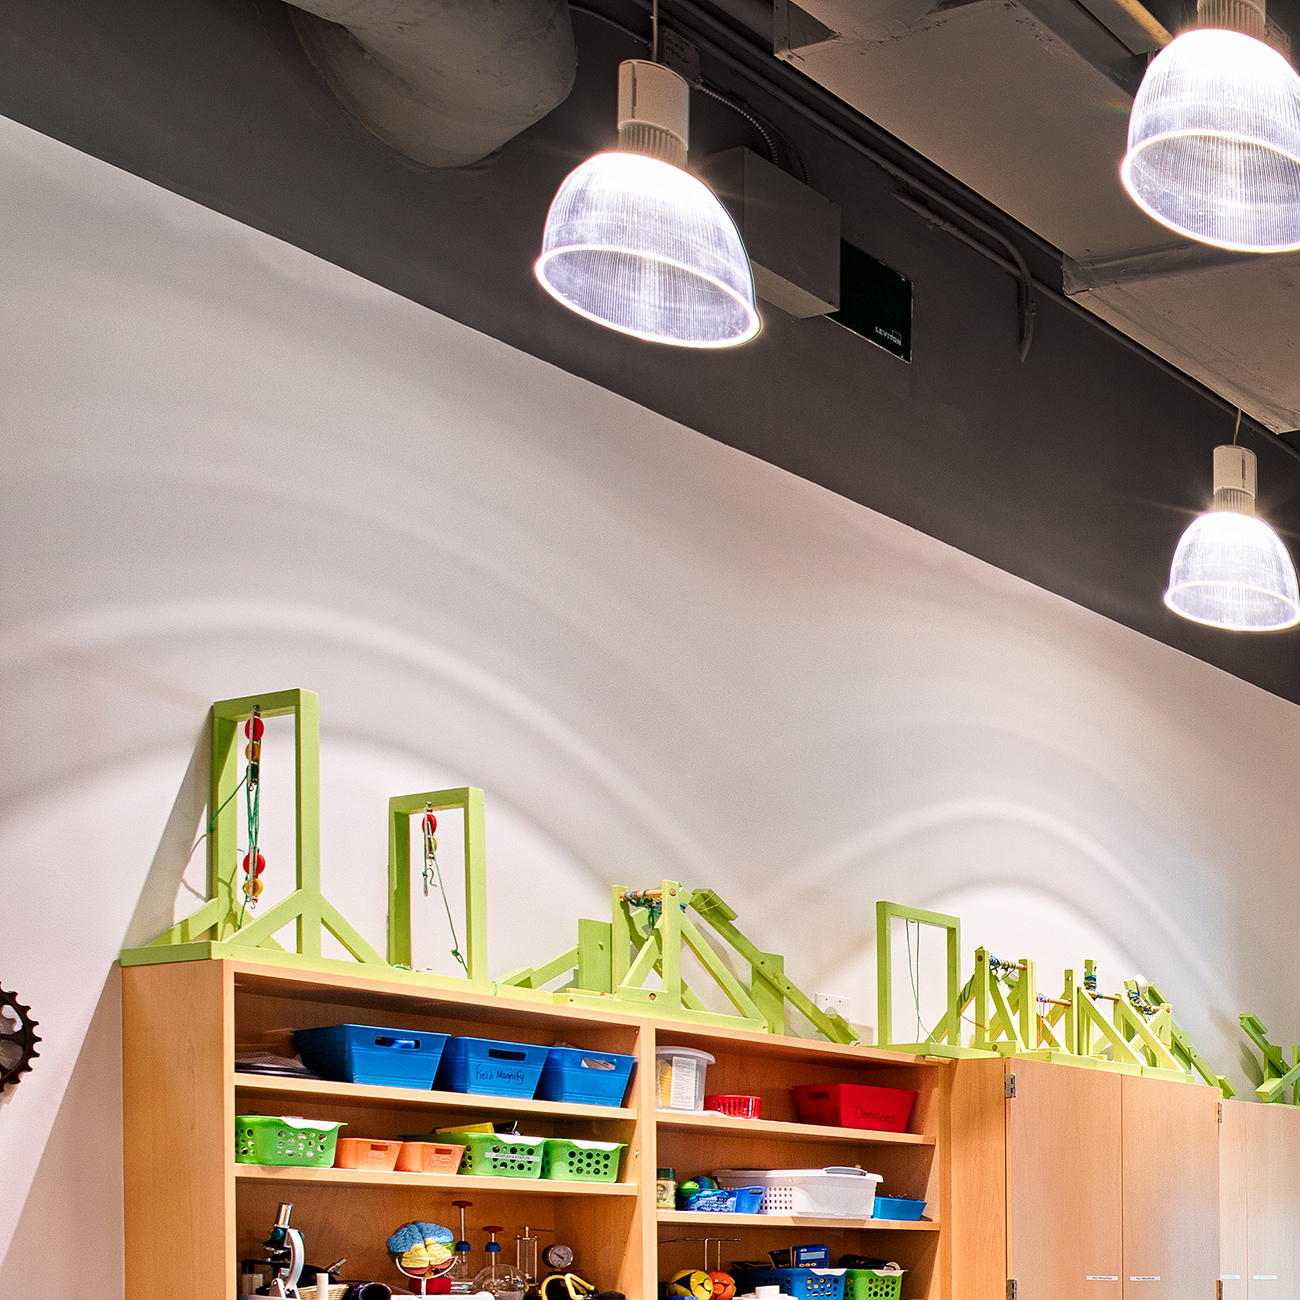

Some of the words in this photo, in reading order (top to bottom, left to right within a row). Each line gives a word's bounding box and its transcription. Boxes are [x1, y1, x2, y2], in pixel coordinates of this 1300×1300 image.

[875, 326, 902, 346] LEVITON
[475, 1063, 494, 1080] Field
[496, 1070, 525, 1085] Magnify
[855, 1105, 898, 1124] Dominoes
